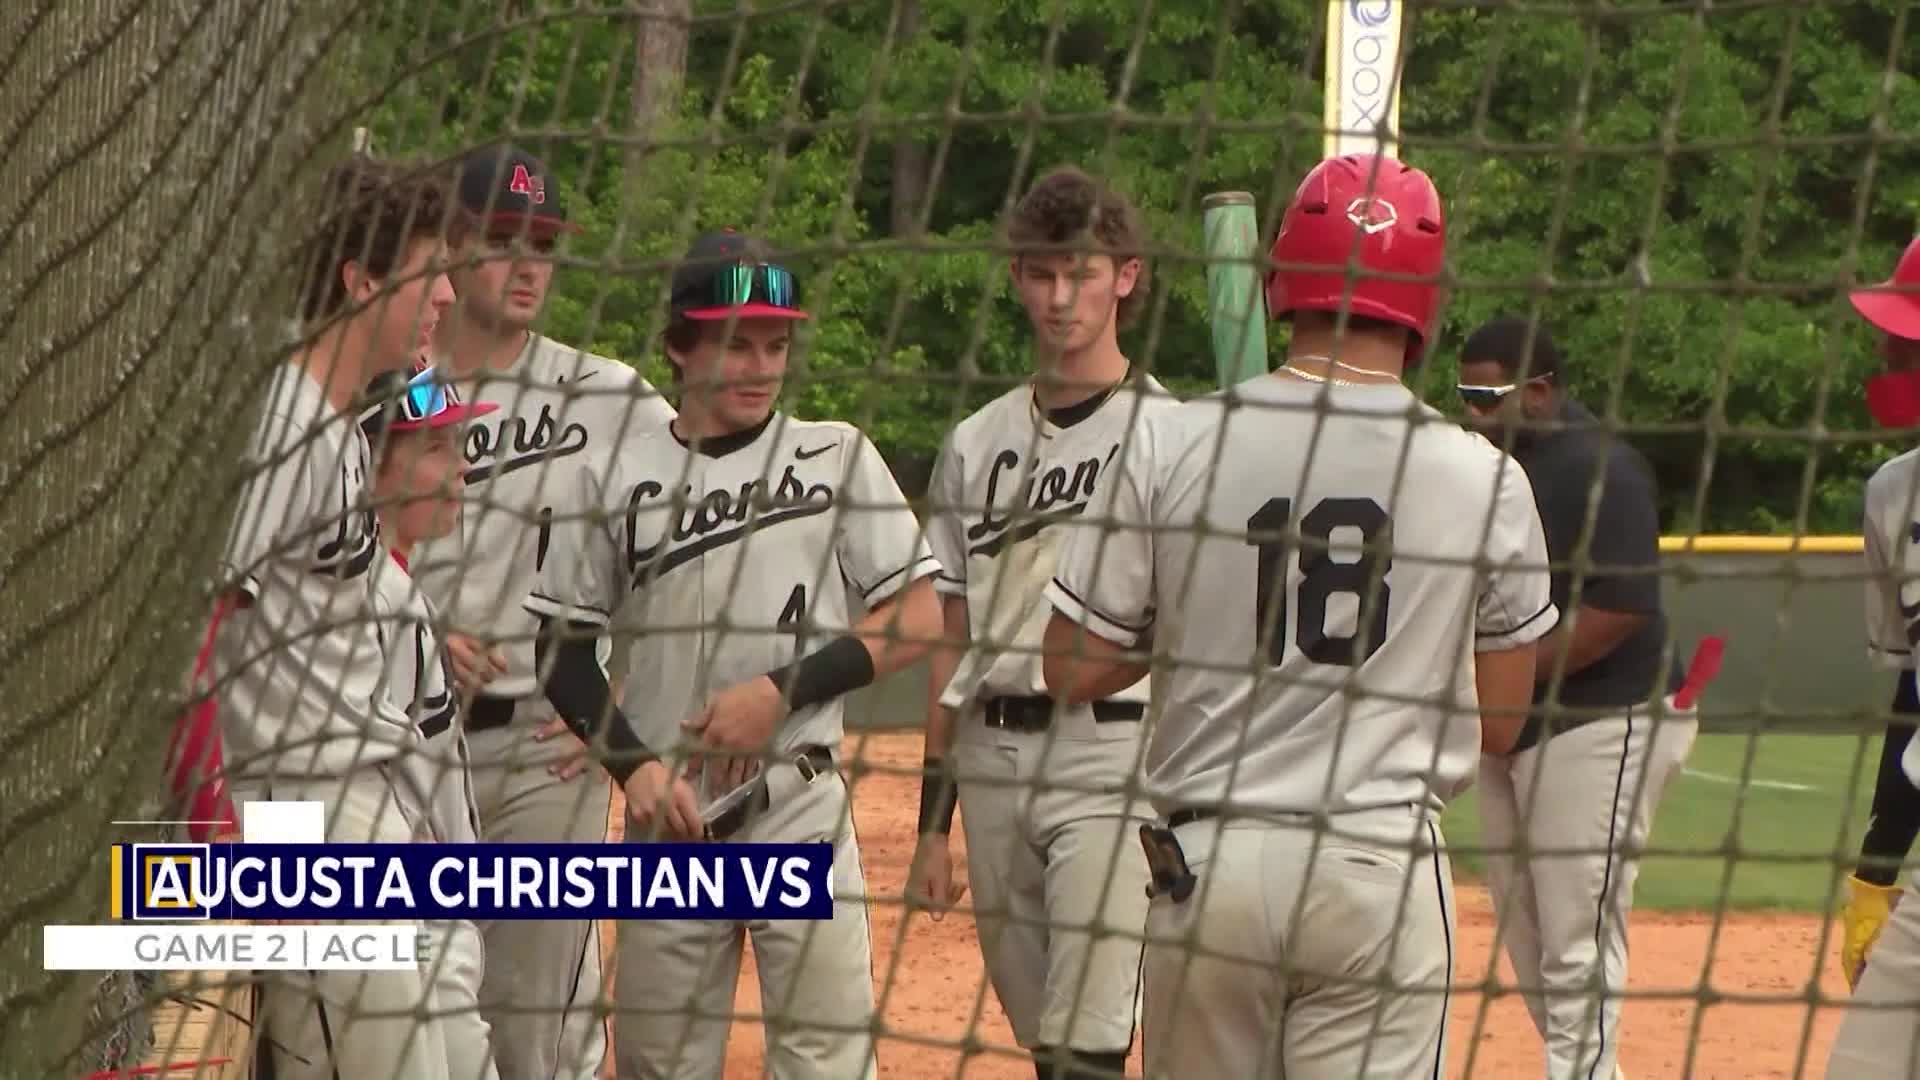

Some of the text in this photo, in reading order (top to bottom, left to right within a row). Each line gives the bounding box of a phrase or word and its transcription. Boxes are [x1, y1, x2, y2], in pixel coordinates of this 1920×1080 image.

[463, 404, 587, 465] ons
[626, 465, 833, 574] Lions
[967, 443, 1120, 541] Lion
[776, 583, 809, 656] 4
[1247, 497, 1394, 668] 18
